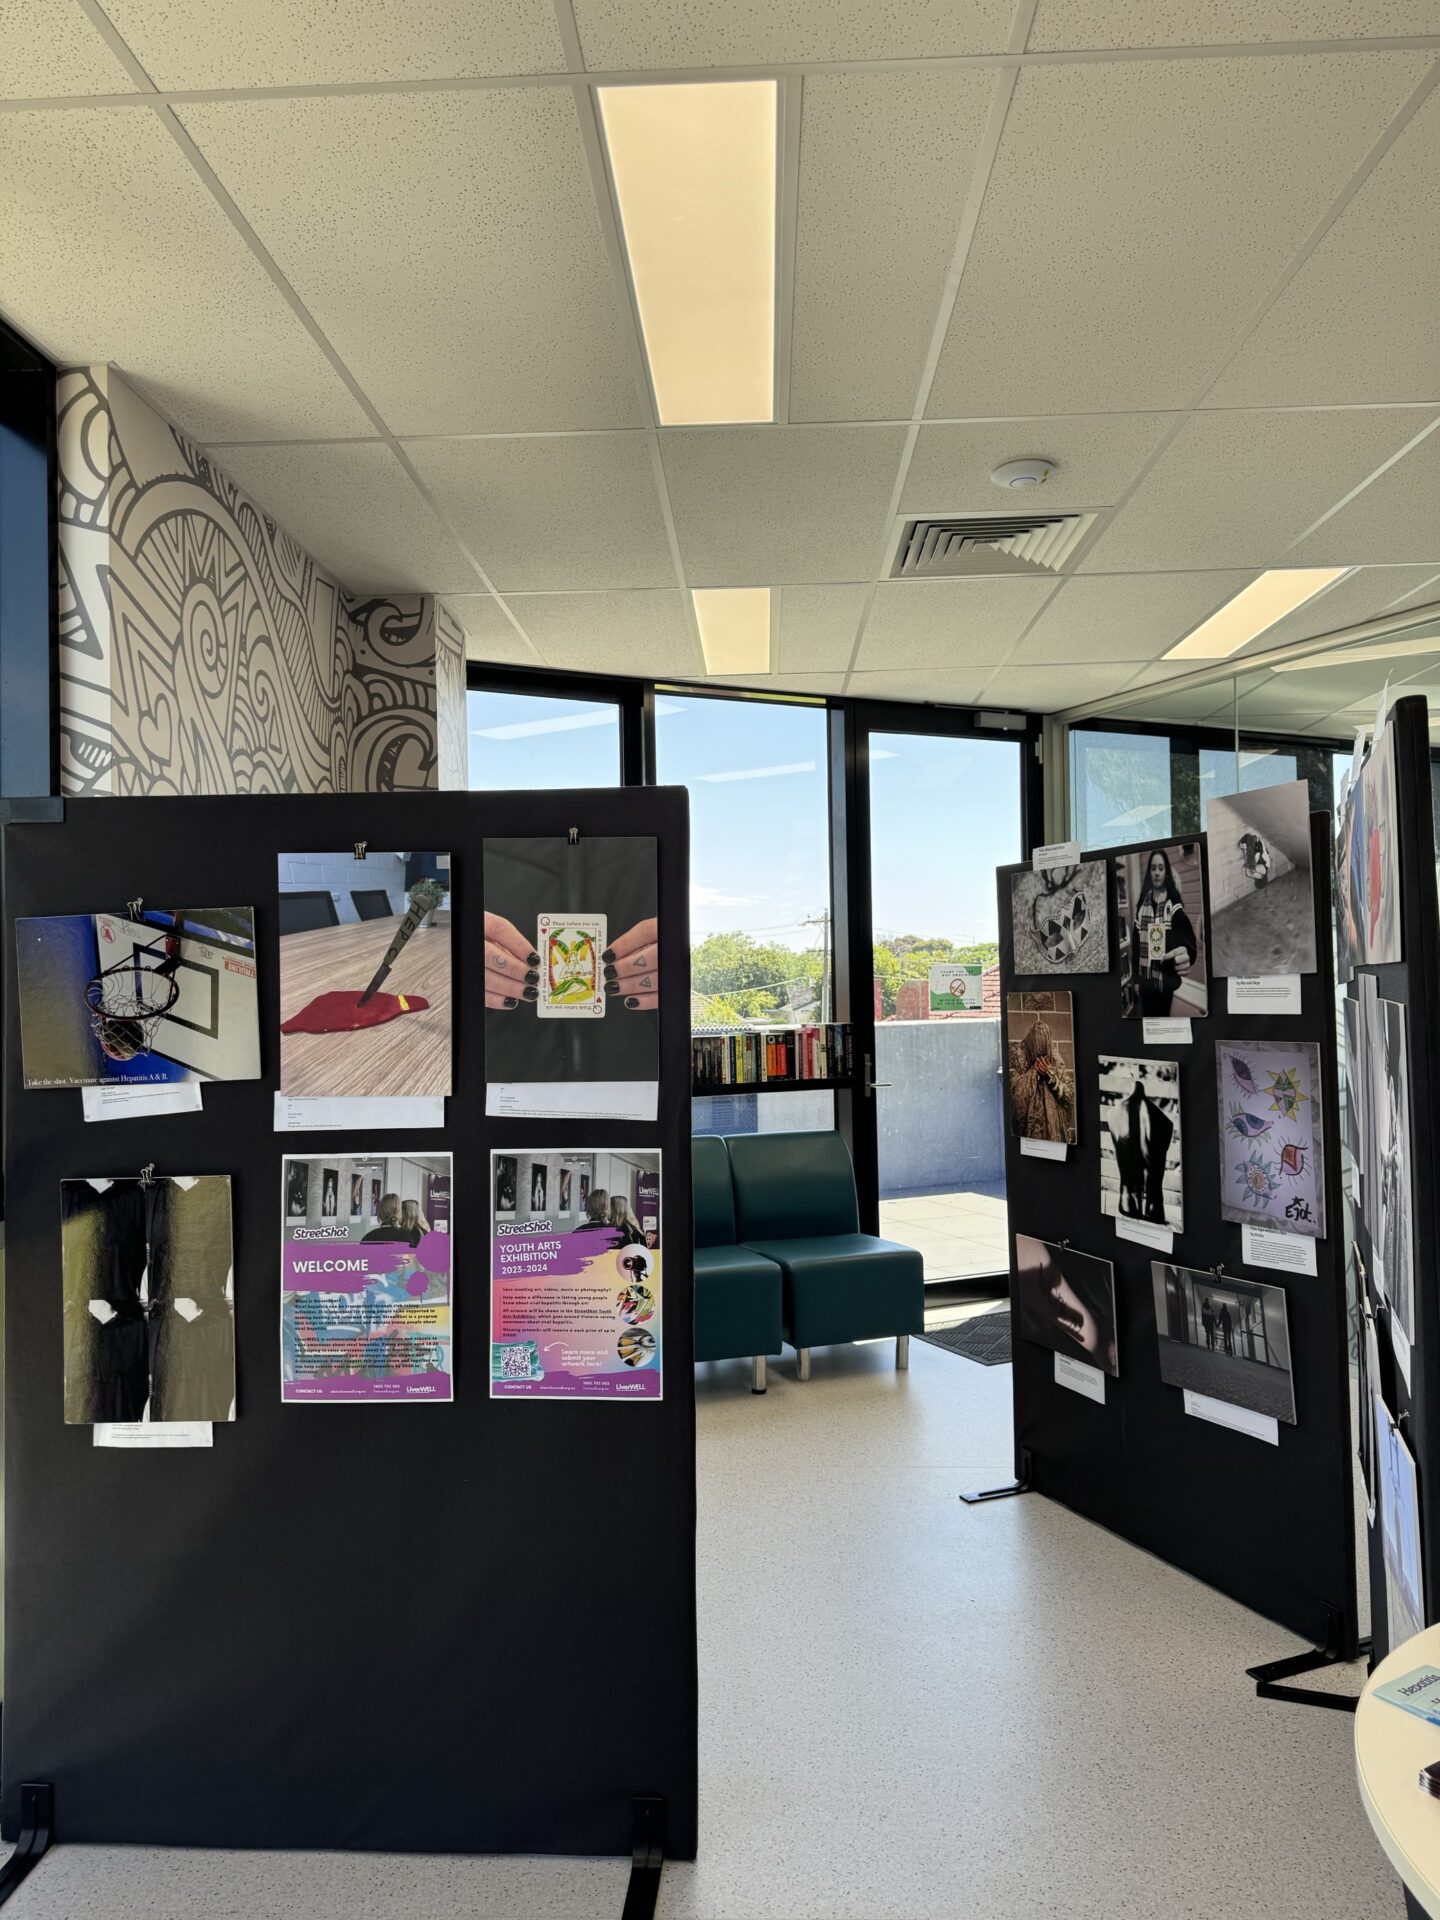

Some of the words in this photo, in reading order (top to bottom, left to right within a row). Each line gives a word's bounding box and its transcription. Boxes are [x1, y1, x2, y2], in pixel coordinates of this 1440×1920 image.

[400, 900, 428, 940] HEP
[388, 948, 398, 958] C
[99, 1076, 120, 1084] against
[121, 1074, 148, 1083] Hepatitis
[294, 1228, 348, 1238] StreetShot
[497, 1222, 551, 1234] StreetShot
[500, 1243, 534, 1253] YOUTH
[537, 1241, 561, 1250] ARTS
[500, 1252, 558, 1263] EXHIBITION
[293, 1259, 368, 1273] WELCOME
[502, 1264, 548, 1274] 2023-2024
